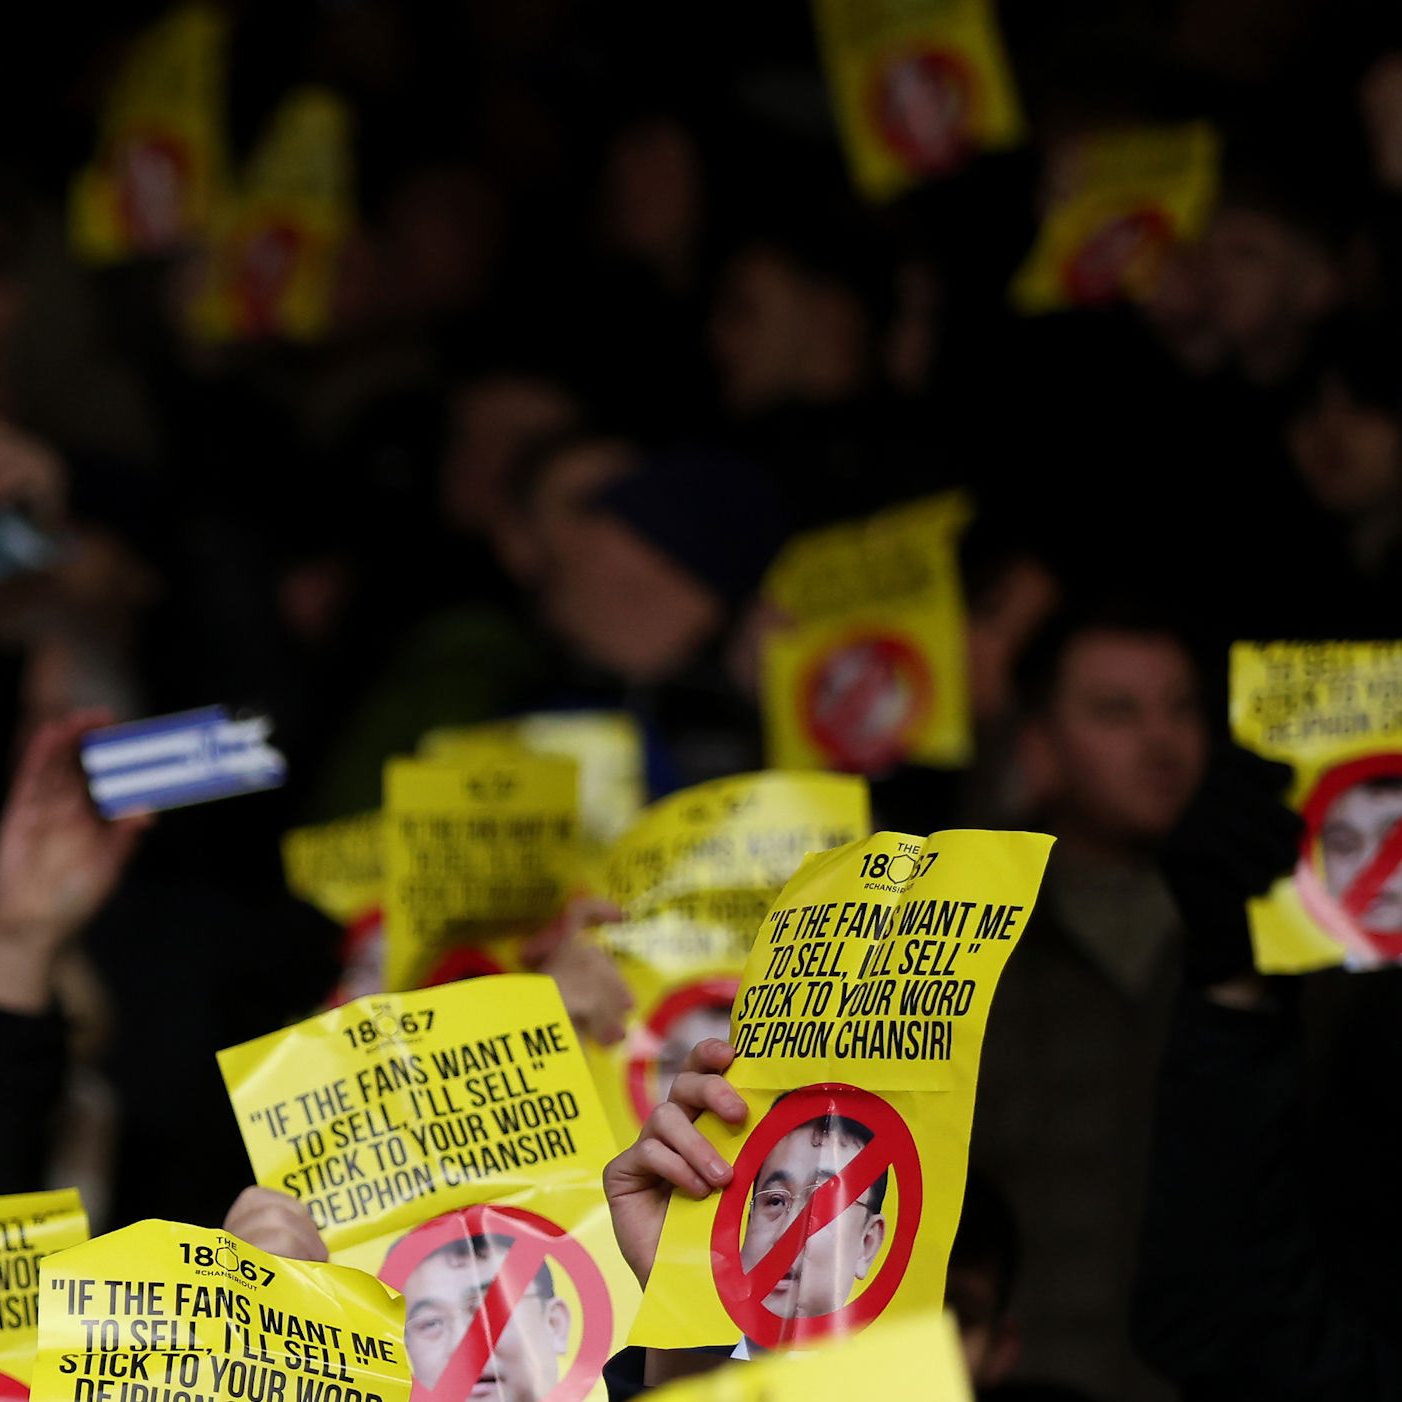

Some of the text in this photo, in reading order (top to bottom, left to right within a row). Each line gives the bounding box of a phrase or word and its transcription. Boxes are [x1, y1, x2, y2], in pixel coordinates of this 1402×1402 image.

[897, 842, 920, 854] THE
[794, 903, 839, 941] THE
[833, 903, 899, 940] FANS
[896, 901, 976, 938] WANT
[974, 906, 1024, 941] ME
[764, 946, 794, 980] TO
[791, 941, 848, 982] SELL,
[857, 940, 892, 979] I'LL
[738, 979, 977, 1021] STICK TO YOUR WORD
[734, 1020, 952, 1060] DEJPHON CHANSIRI
[296, 1079, 354, 1125] THE
[357, 1056, 428, 1098] FANS
[431, 1035, 515, 1081] WANT
[522, 1023, 569, 1059] ME
[283, 1090, 580, 1199] STICK TO YOUR WORD
[288, 1129, 325, 1166] TO
[330, 1104, 409, 1150] SELL,
[408, 1085, 464, 1120] I'LL
[307, 1127, 578, 1231] DEJPHON CHANSIRI
[216, 1237, 238, 1251] THE
[195, 1268, 258, 1292] #CHANSIRIOUT
[80, 1319, 120, 1353] TO
[130, 1320, 212, 1356] SELL,
[225, 1321, 276, 1364] I'LL
[104, 1280, 166, 1316] THE
[175, 1284, 251, 1325] FANS
[259, 1304, 342, 1350] WANT
[353, 1331, 398, 1364] ME
[59, 1353, 149, 1380] STICK
[162, 1353, 199, 1388] TO
